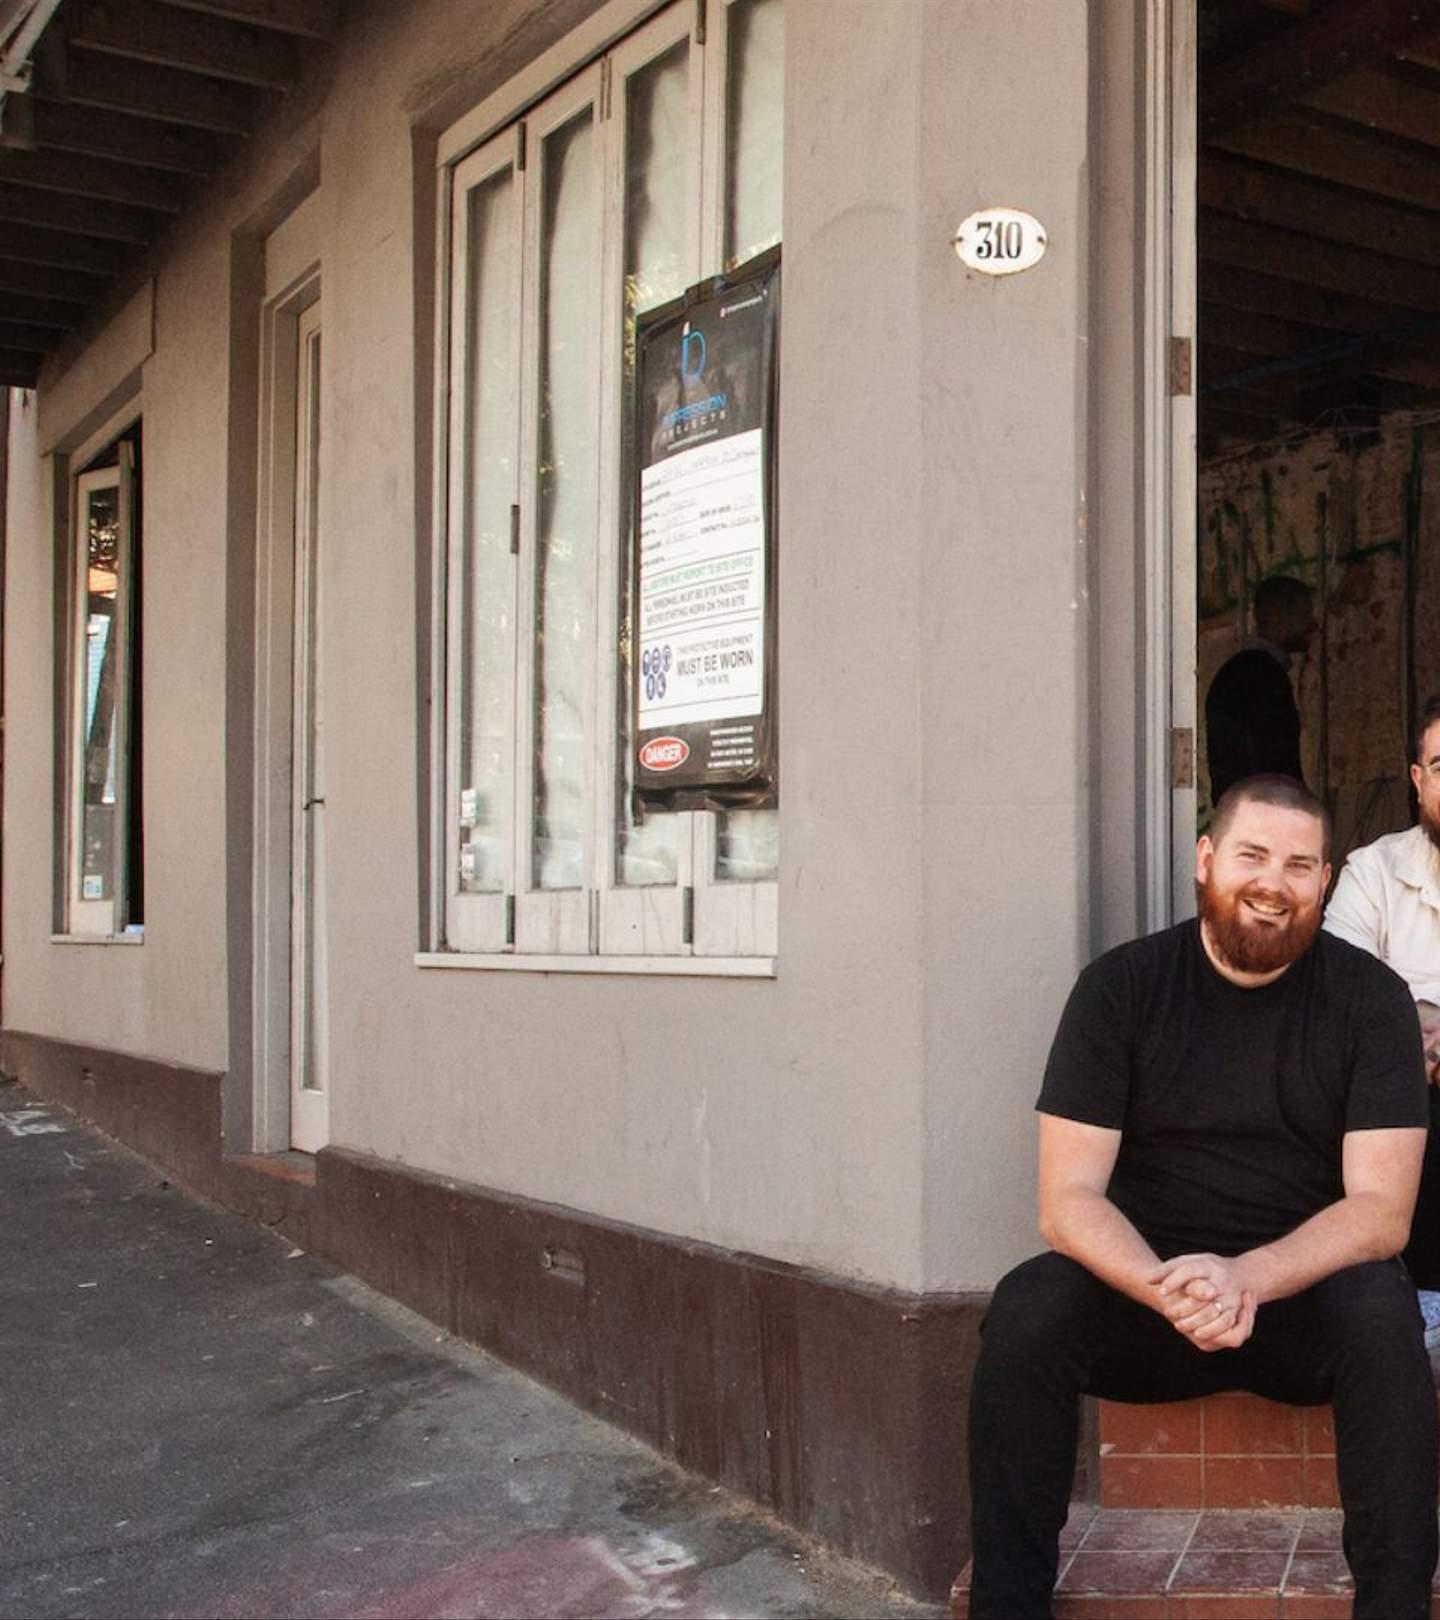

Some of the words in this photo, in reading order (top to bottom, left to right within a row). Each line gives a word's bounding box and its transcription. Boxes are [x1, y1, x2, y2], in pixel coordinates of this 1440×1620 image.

[976, 221, 1023, 259] 310
[677, 656, 701, 677] MUST
[704, 654, 717, 673] BE
[720, 648, 753, 670] WORN
[645, 744, 682, 763] DANGER
